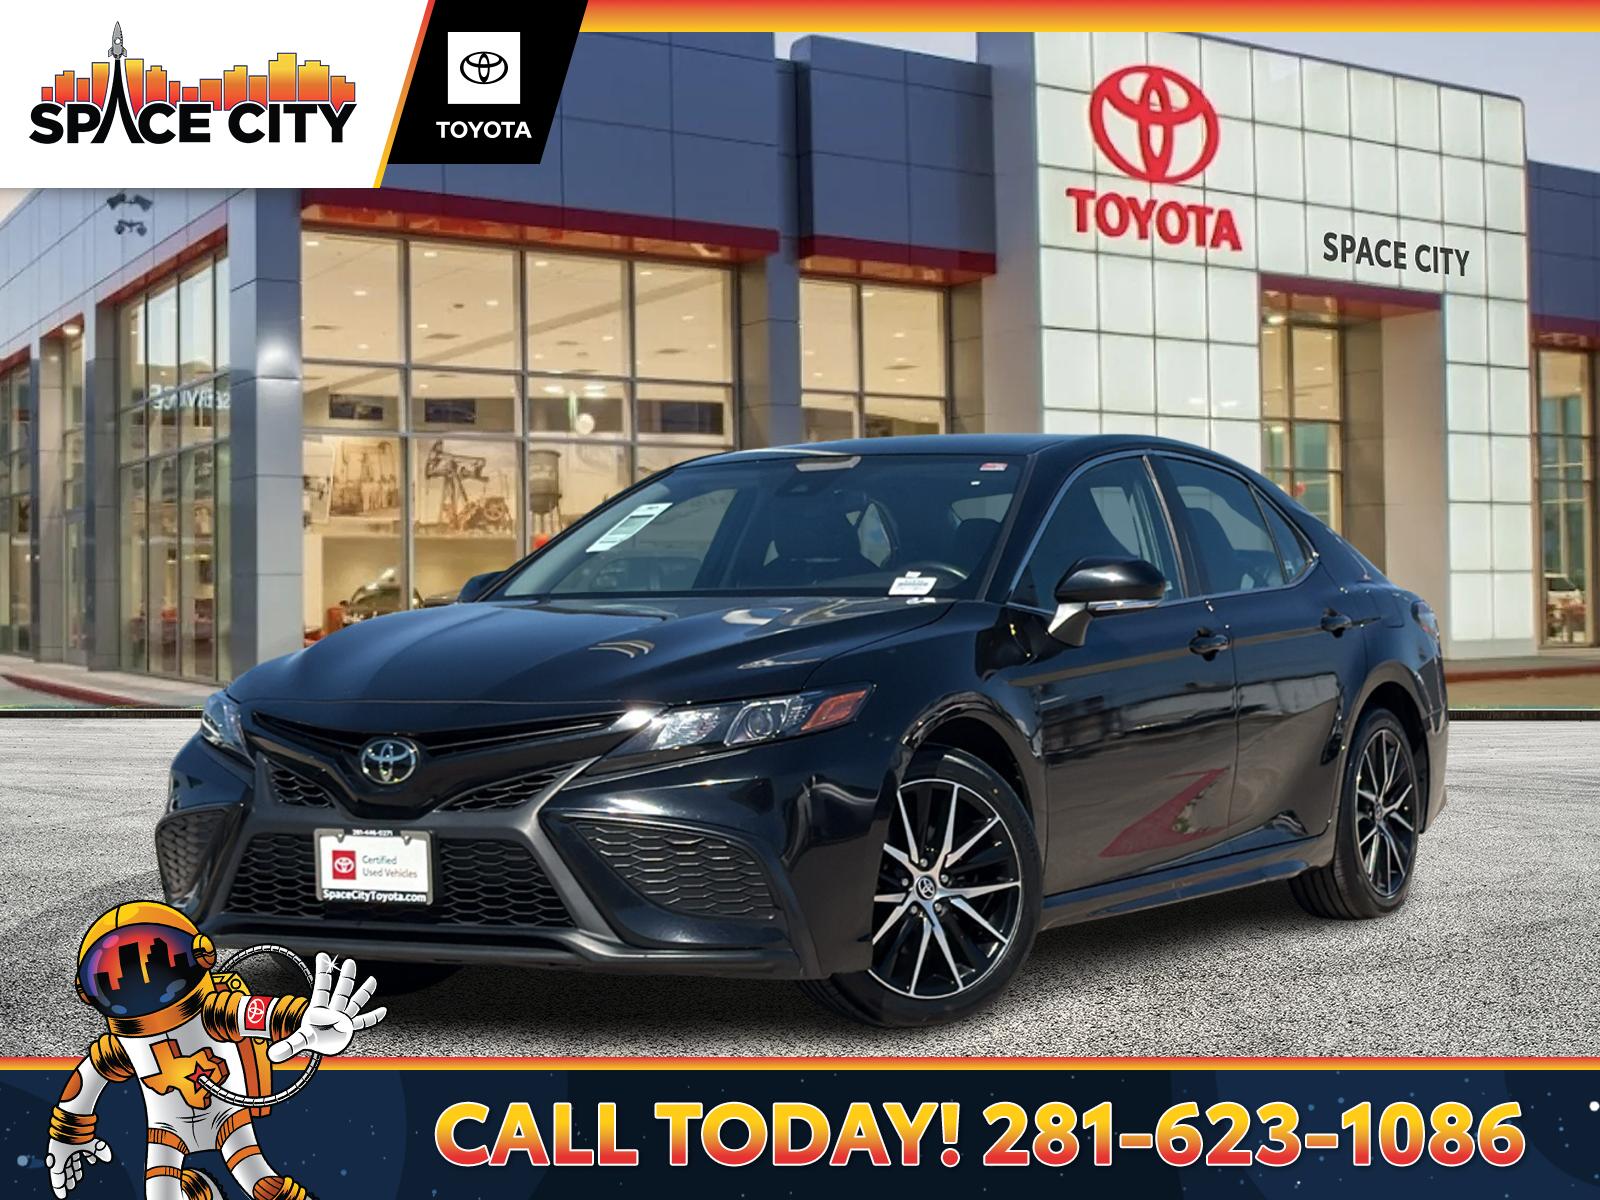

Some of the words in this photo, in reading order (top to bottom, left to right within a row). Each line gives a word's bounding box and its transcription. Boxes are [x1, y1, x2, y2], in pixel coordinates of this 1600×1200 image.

[1066, 188, 1242, 251] TOYOTA
[1323, 232, 1407, 270] SPACE
[1414, 244, 1470, 277] CITY
[362, 855, 398, 865] Certified
[362, 868, 383, 877] Used
[384, 869, 418, 879] Vehicles
[323, 889, 427, 902] SpaceCityToyota.com
